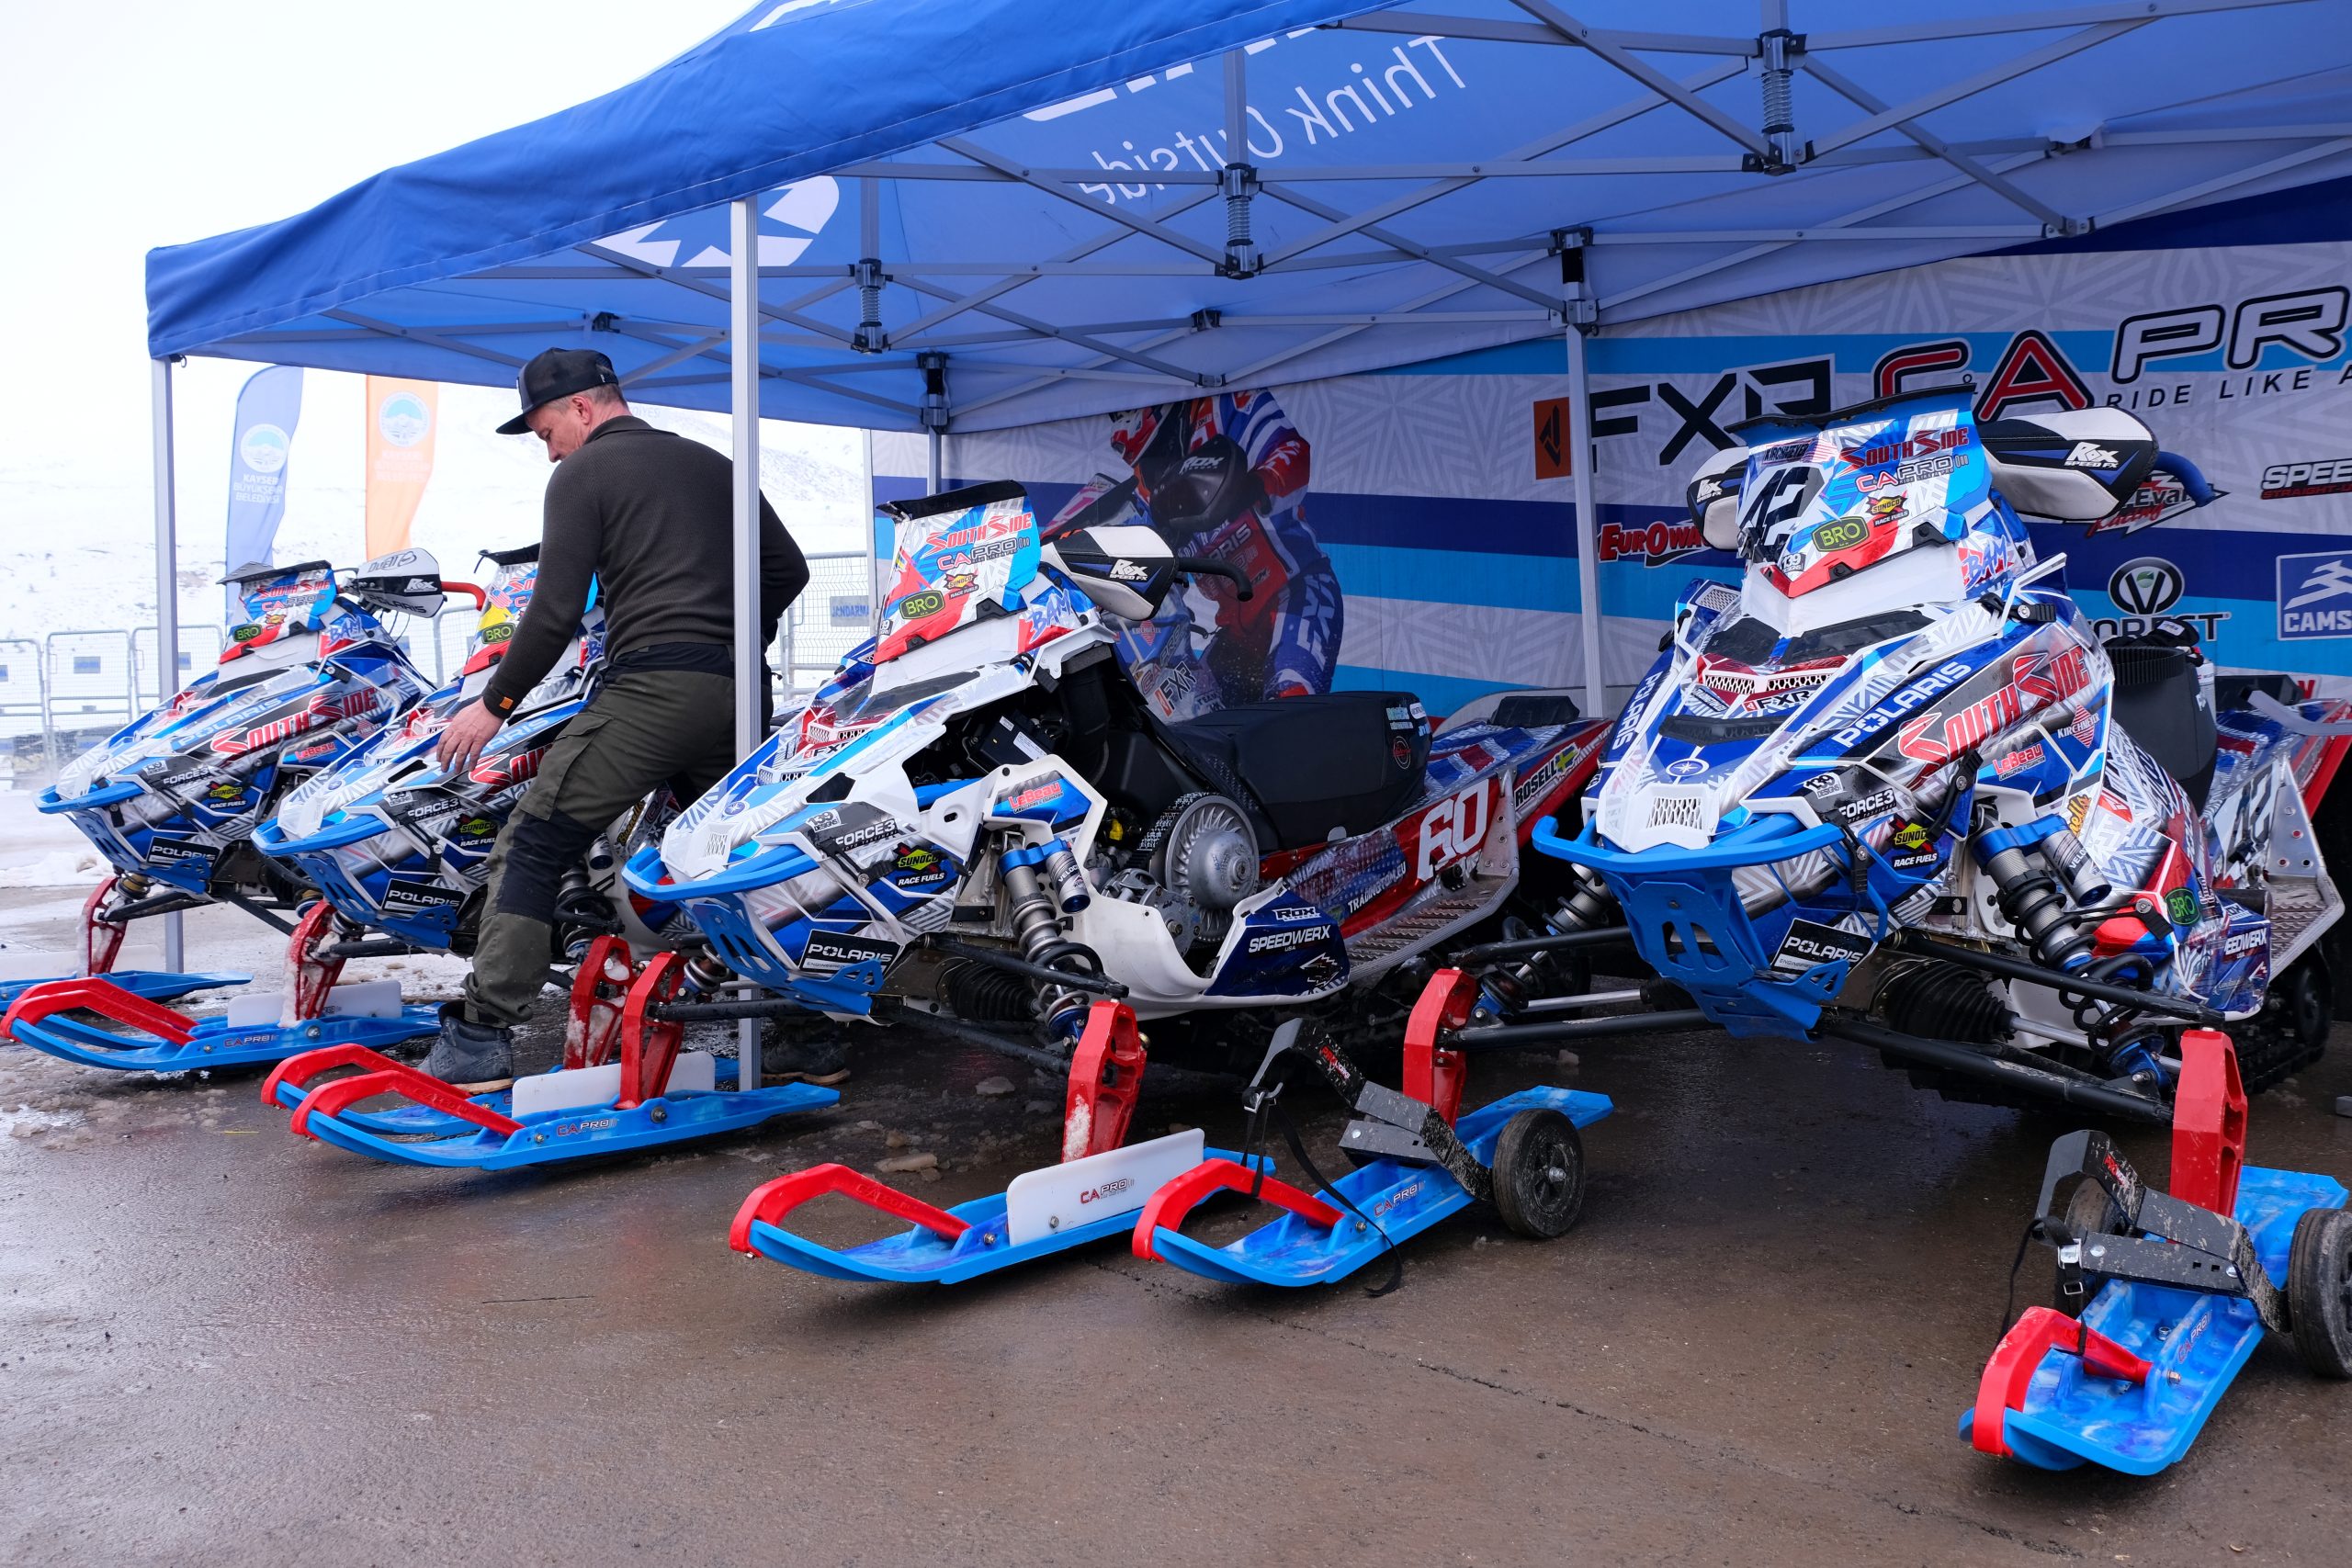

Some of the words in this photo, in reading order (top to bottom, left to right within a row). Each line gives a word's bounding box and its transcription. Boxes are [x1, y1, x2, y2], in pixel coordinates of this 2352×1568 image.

[2107, 384, 2192, 409] RIDE
[2219, 369, 2310, 400] LIKE
[1871, 499, 1902, 513] SUNOCO
[1875, 515, 1891, 526] RACE
[1891, 511, 1909, 521] FUELS
[1599, 522, 1712, 561] EUROWA
[1819, 522, 1860, 547] BRO
[1781, 553, 1802, 568] 139
[1962, 534, 2008, 591] BAM
[948, 576, 974, 589] SUNOCO
[1109, 572, 1135, 581] SPEED
[964, 586, 978, 595] FUELS
[368, 594, 427, 614] POLARIS
[905, 594, 939, 615] BRO
[237, 626, 258, 639] BRO
[486, 626, 512, 640] BRO
[1756, 690, 1811, 710] FXR
[1831, 661, 1973, 749] POLARIS
[1611, 671, 1664, 750] POLARIS
[177, 699, 282, 746] POLARIS
[2057, 713, 2101, 739] KIRCHMEYER
[490, 717, 549, 750] ARIS
[1992, 742, 2044, 775] LeBeau
[1514, 761, 1558, 807] ROSELL
[1806, 774, 1836, 789] 139
[1817, 784, 1840, 797] DESIGNS
[210, 787, 243, 797] SUNOCO
[1008, 782, 1063, 809] LeBeau
[407, 797, 459, 818] FORCE3
[1838, 789, 1895, 818] FORCE3
[815, 819, 838, 831] DESIGNS
[835, 819, 896, 846] FORCE3
[1417, 779, 1489, 882] 60
[460, 839, 480, 847] RACE
[1894, 829, 1928, 845] SUNOC
[152, 845, 216, 861] POLARIS
[1894, 856, 1915, 868] RACE
[1915, 853, 1938, 865] FUELS
[898, 876, 921, 886] RACE
[921, 873, 945, 883] FUELS
[1058, 863, 1079, 883] VELOC
[389, 889, 460, 908] POLARIS
[2169, 895, 2195, 919] BRO
[1276, 907, 1316, 919] ROX
[1249, 924, 1331, 953] SPEEDWERX
[2224, 927, 2267, 955] EEDWERX
[808, 943, 893, 962] POLARIS
[1784, 936, 1864, 963] POLARIS
